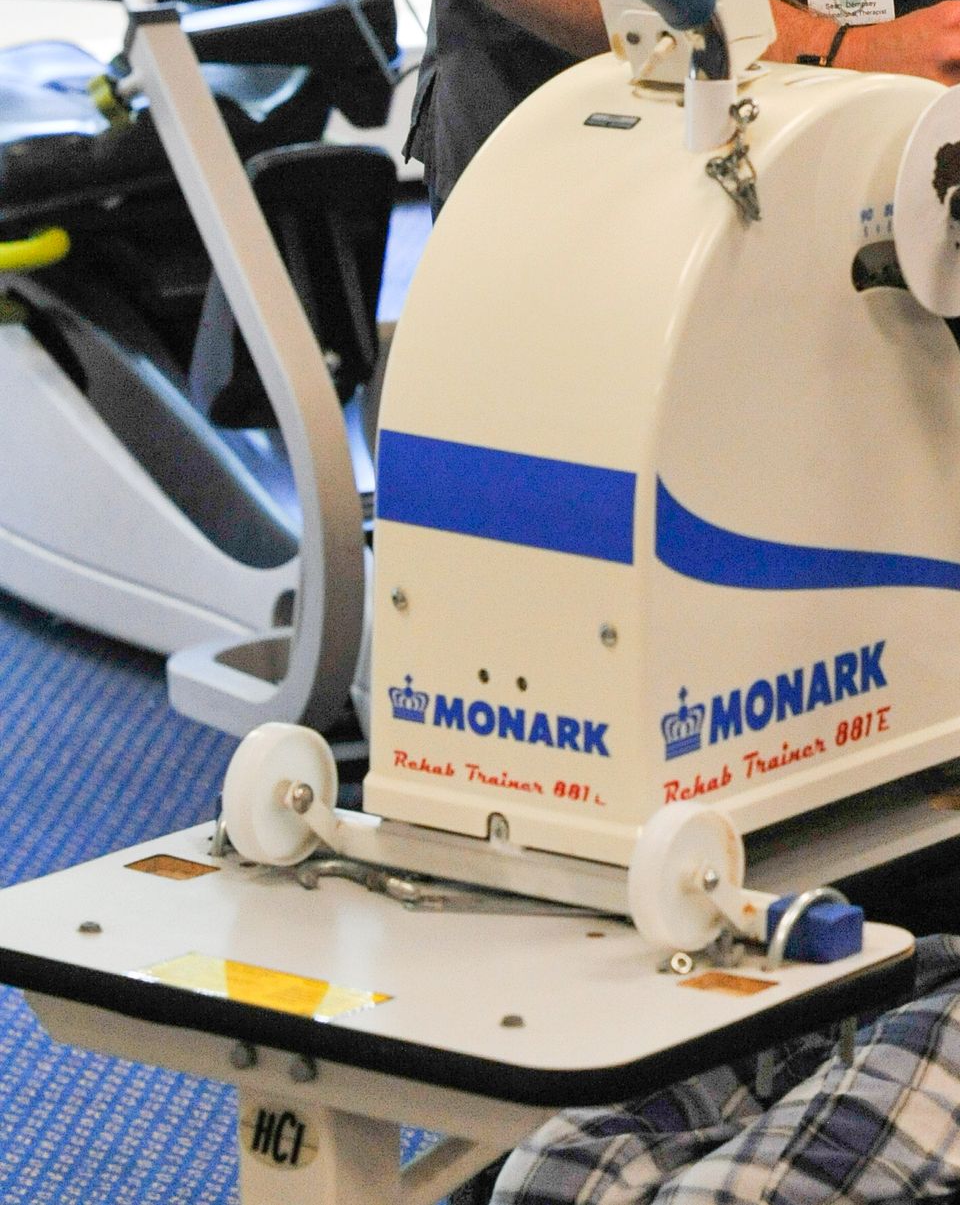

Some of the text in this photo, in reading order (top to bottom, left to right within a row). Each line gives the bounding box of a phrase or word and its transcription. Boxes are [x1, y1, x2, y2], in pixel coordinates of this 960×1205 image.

[708, 639, 888, 746] MONARK
[433, 694, 610, 758] MONARK
[393, 750, 455, 777] Rehab
[465, 763, 544, 795] Trainer
[663, 764, 732, 805] Rehab
[743, 739, 826, 780] Trainer
